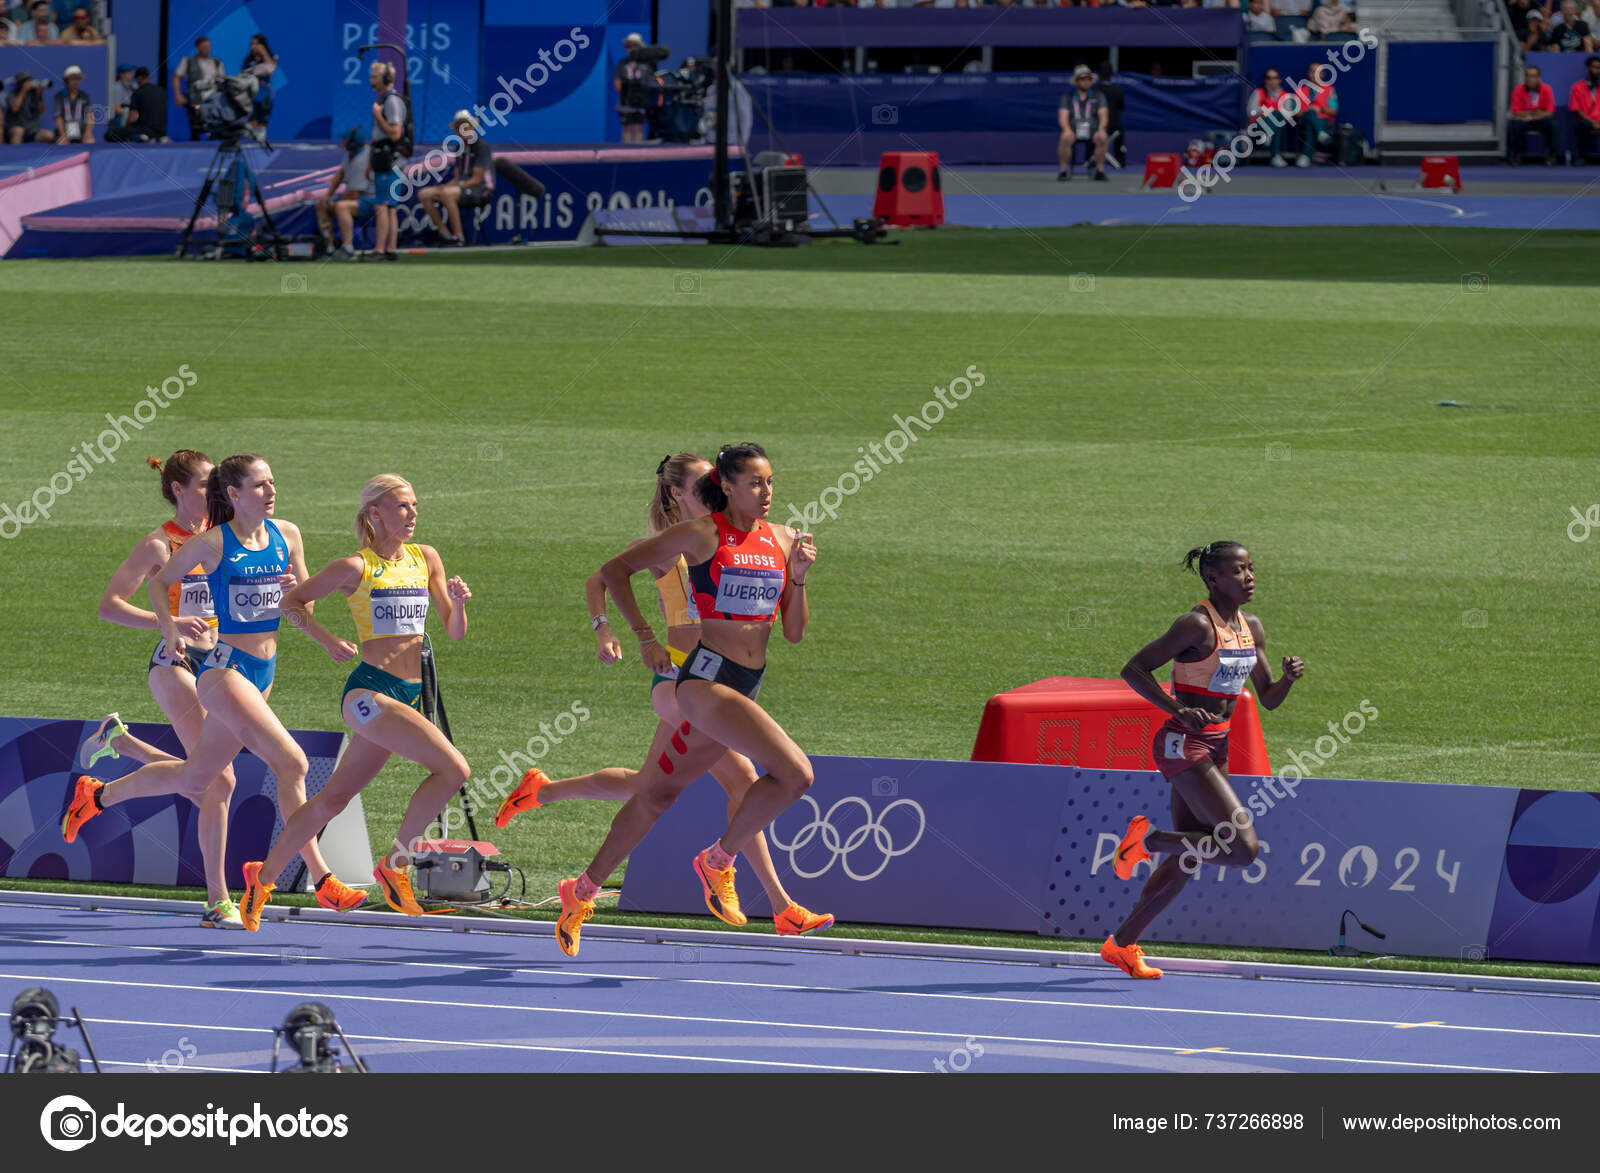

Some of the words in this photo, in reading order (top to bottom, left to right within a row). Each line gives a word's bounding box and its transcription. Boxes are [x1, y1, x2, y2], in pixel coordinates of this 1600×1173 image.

[343, 56, 450, 84] 224
[244, 564, 283, 575] ITALIA
[234, 590, 281, 607] COIRO
[723, 583, 778, 600] WERRO
[700, 655, 713, 672] 7
[356, 700, 371, 717] 5
